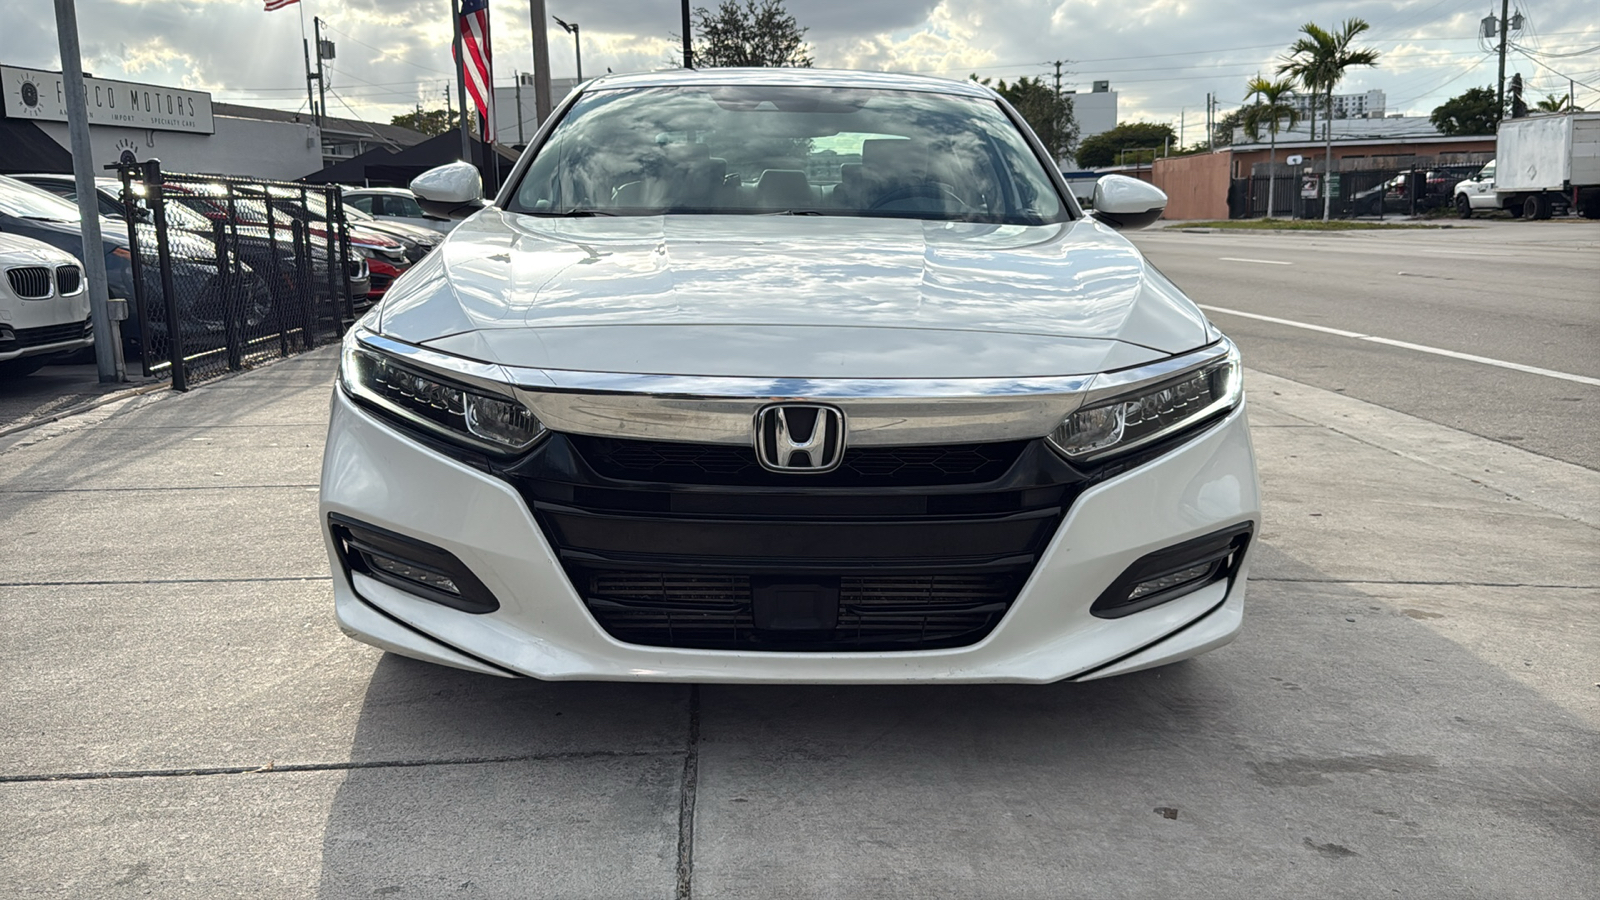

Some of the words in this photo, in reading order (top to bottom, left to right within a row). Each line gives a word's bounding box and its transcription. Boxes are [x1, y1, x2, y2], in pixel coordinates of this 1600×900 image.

[56, 80, 115, 109] FRCO
[130, 89, 195, 117] MOTORS
[111, 114, 135, 122] IMPORT
[151, 117, 180, 126] SPECIALTY
[181, 120, 196, 128] CARS
